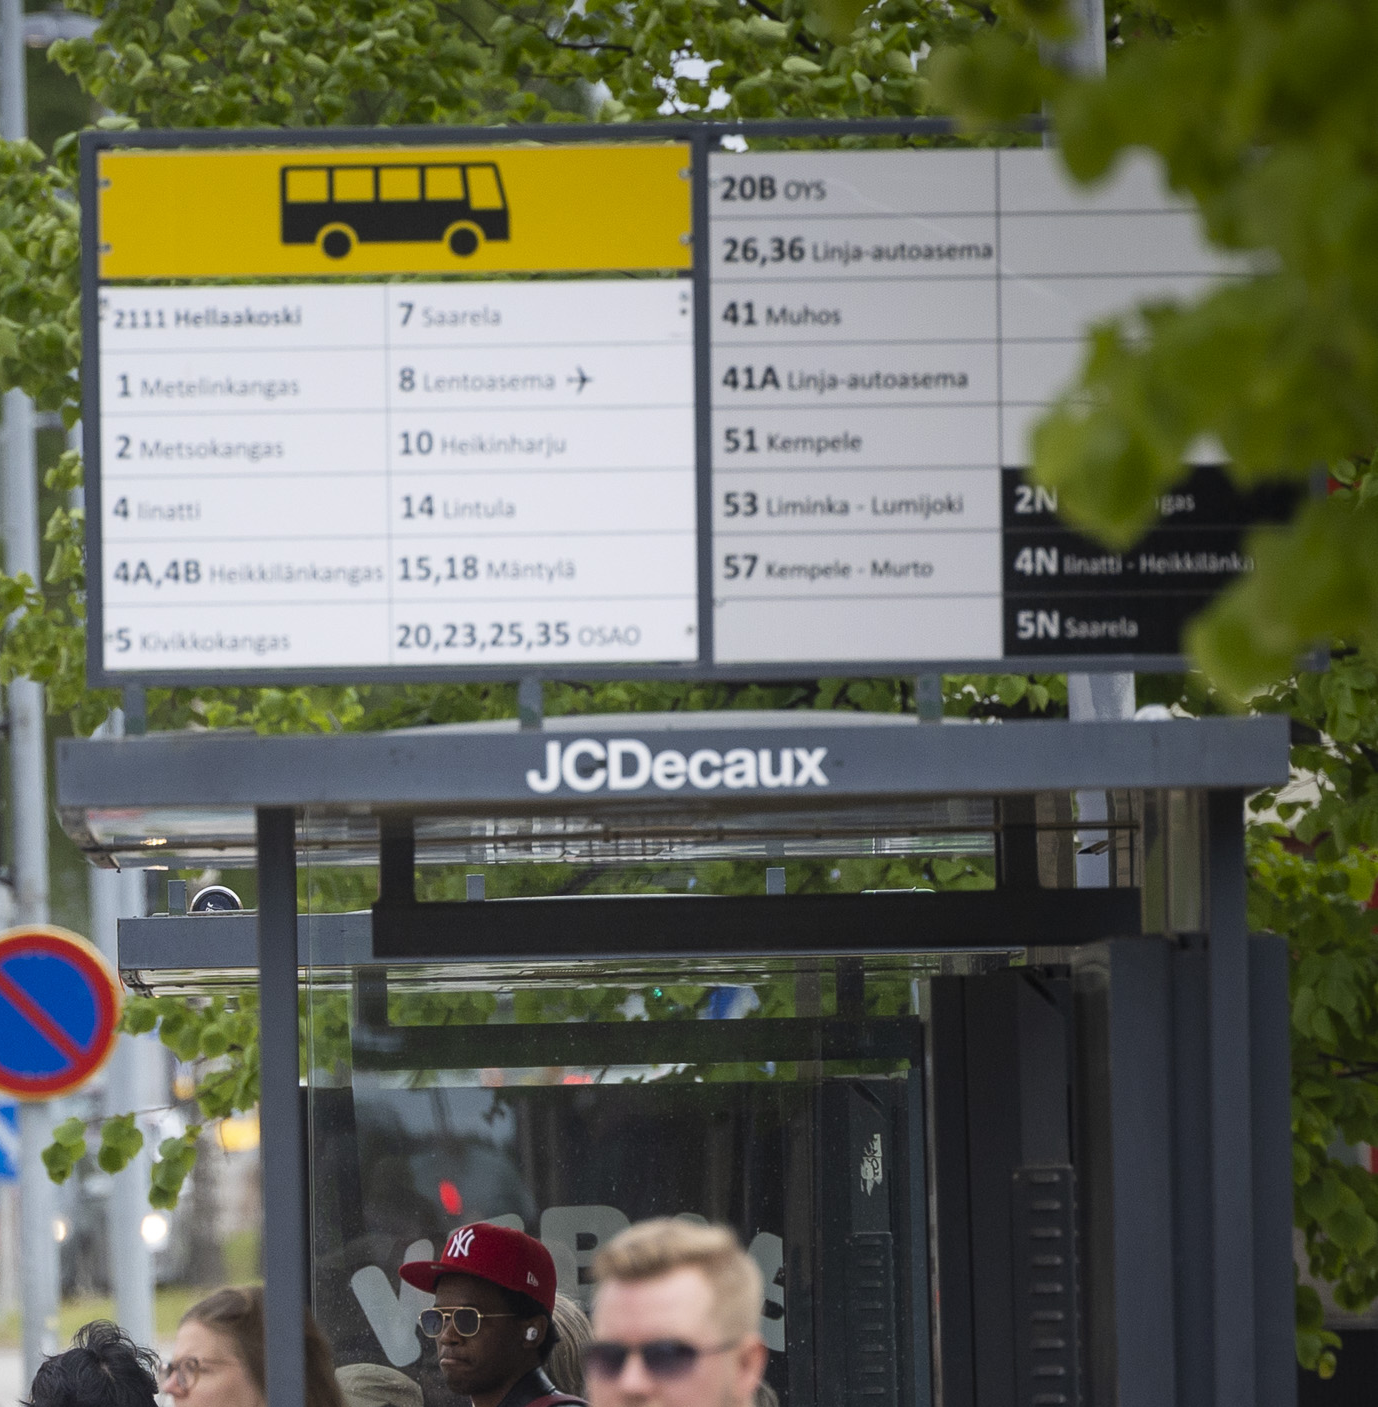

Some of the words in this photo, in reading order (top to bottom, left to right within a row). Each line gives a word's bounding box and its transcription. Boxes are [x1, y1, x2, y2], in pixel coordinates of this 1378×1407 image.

[721, 175, 777, 201] 20B
[783, 180, 827, 201] OYS
[723, 236, 805, 266] 26,36
[812, 238, 993, 265] Linja-autoasema
[114, 309, 166, 329] 2111
[174, 307, 301, 328] Hellaakoski
[399, 302, 414, 326] 7
[422, 306, 502, 327] Saarela
[722, 301, 757, 326] 41
[765, 305, 842, 326] Muhos
[119, 374, 131, 397] 1
[140, 377, 300, 401] Metelinkangas
[399, 367, 416, 392] 8
[423, 374, 556, 392] Lentoasema
[722, 366, 781, 391] 41A
[788, 371, 969, 394] Linja-autoasema
[117, 435, 131, 459] 2
[140, 440, 284, 463] Metsokangas
[401, 430, 434, 455] 10
[440, 435, 567, 458] Heikinharju
[725, 428, 758, 453] 51
[767, 431, 863, 456] Kempele
[113, 497, 129, 519] 4
[137, 503, 201, 521] Iinatti
[403, 495, 435, 519] 14
[443, 498, 516, 520] Lintula
[724, 492, 759, 517] 53
[766, 496, 850, 517] Liminka
[871, 494, 964, 520] Lumijoki
[1015, 484, 1058, 514] 2N
[114, 560, 201, 587] 4A,4B
[209, 564, 384, 587] Heikkilänkangas
[399, 555, 479, 584] 15,18
[486, 560, 576, 583] Mäntylä
[724, 554, 758, 580] 57
[766, 561, 852, 582] Kempele
[871, 560, 934, 578] Murto
[1015, 547, 1058, 575] 4N
[1063, 550, 1122, 575] Iinatti
[397, 621, 570, 651] 20,23,25,35
[577, 625, 641, 647] OSAO
[1018, 611, 1059, 639] 5N
[1064, 617, 1138, 638] Saarela
[140, 633, 290, 656] Kivikkokangas
[525, 738, 830, 794] JCDecaux
